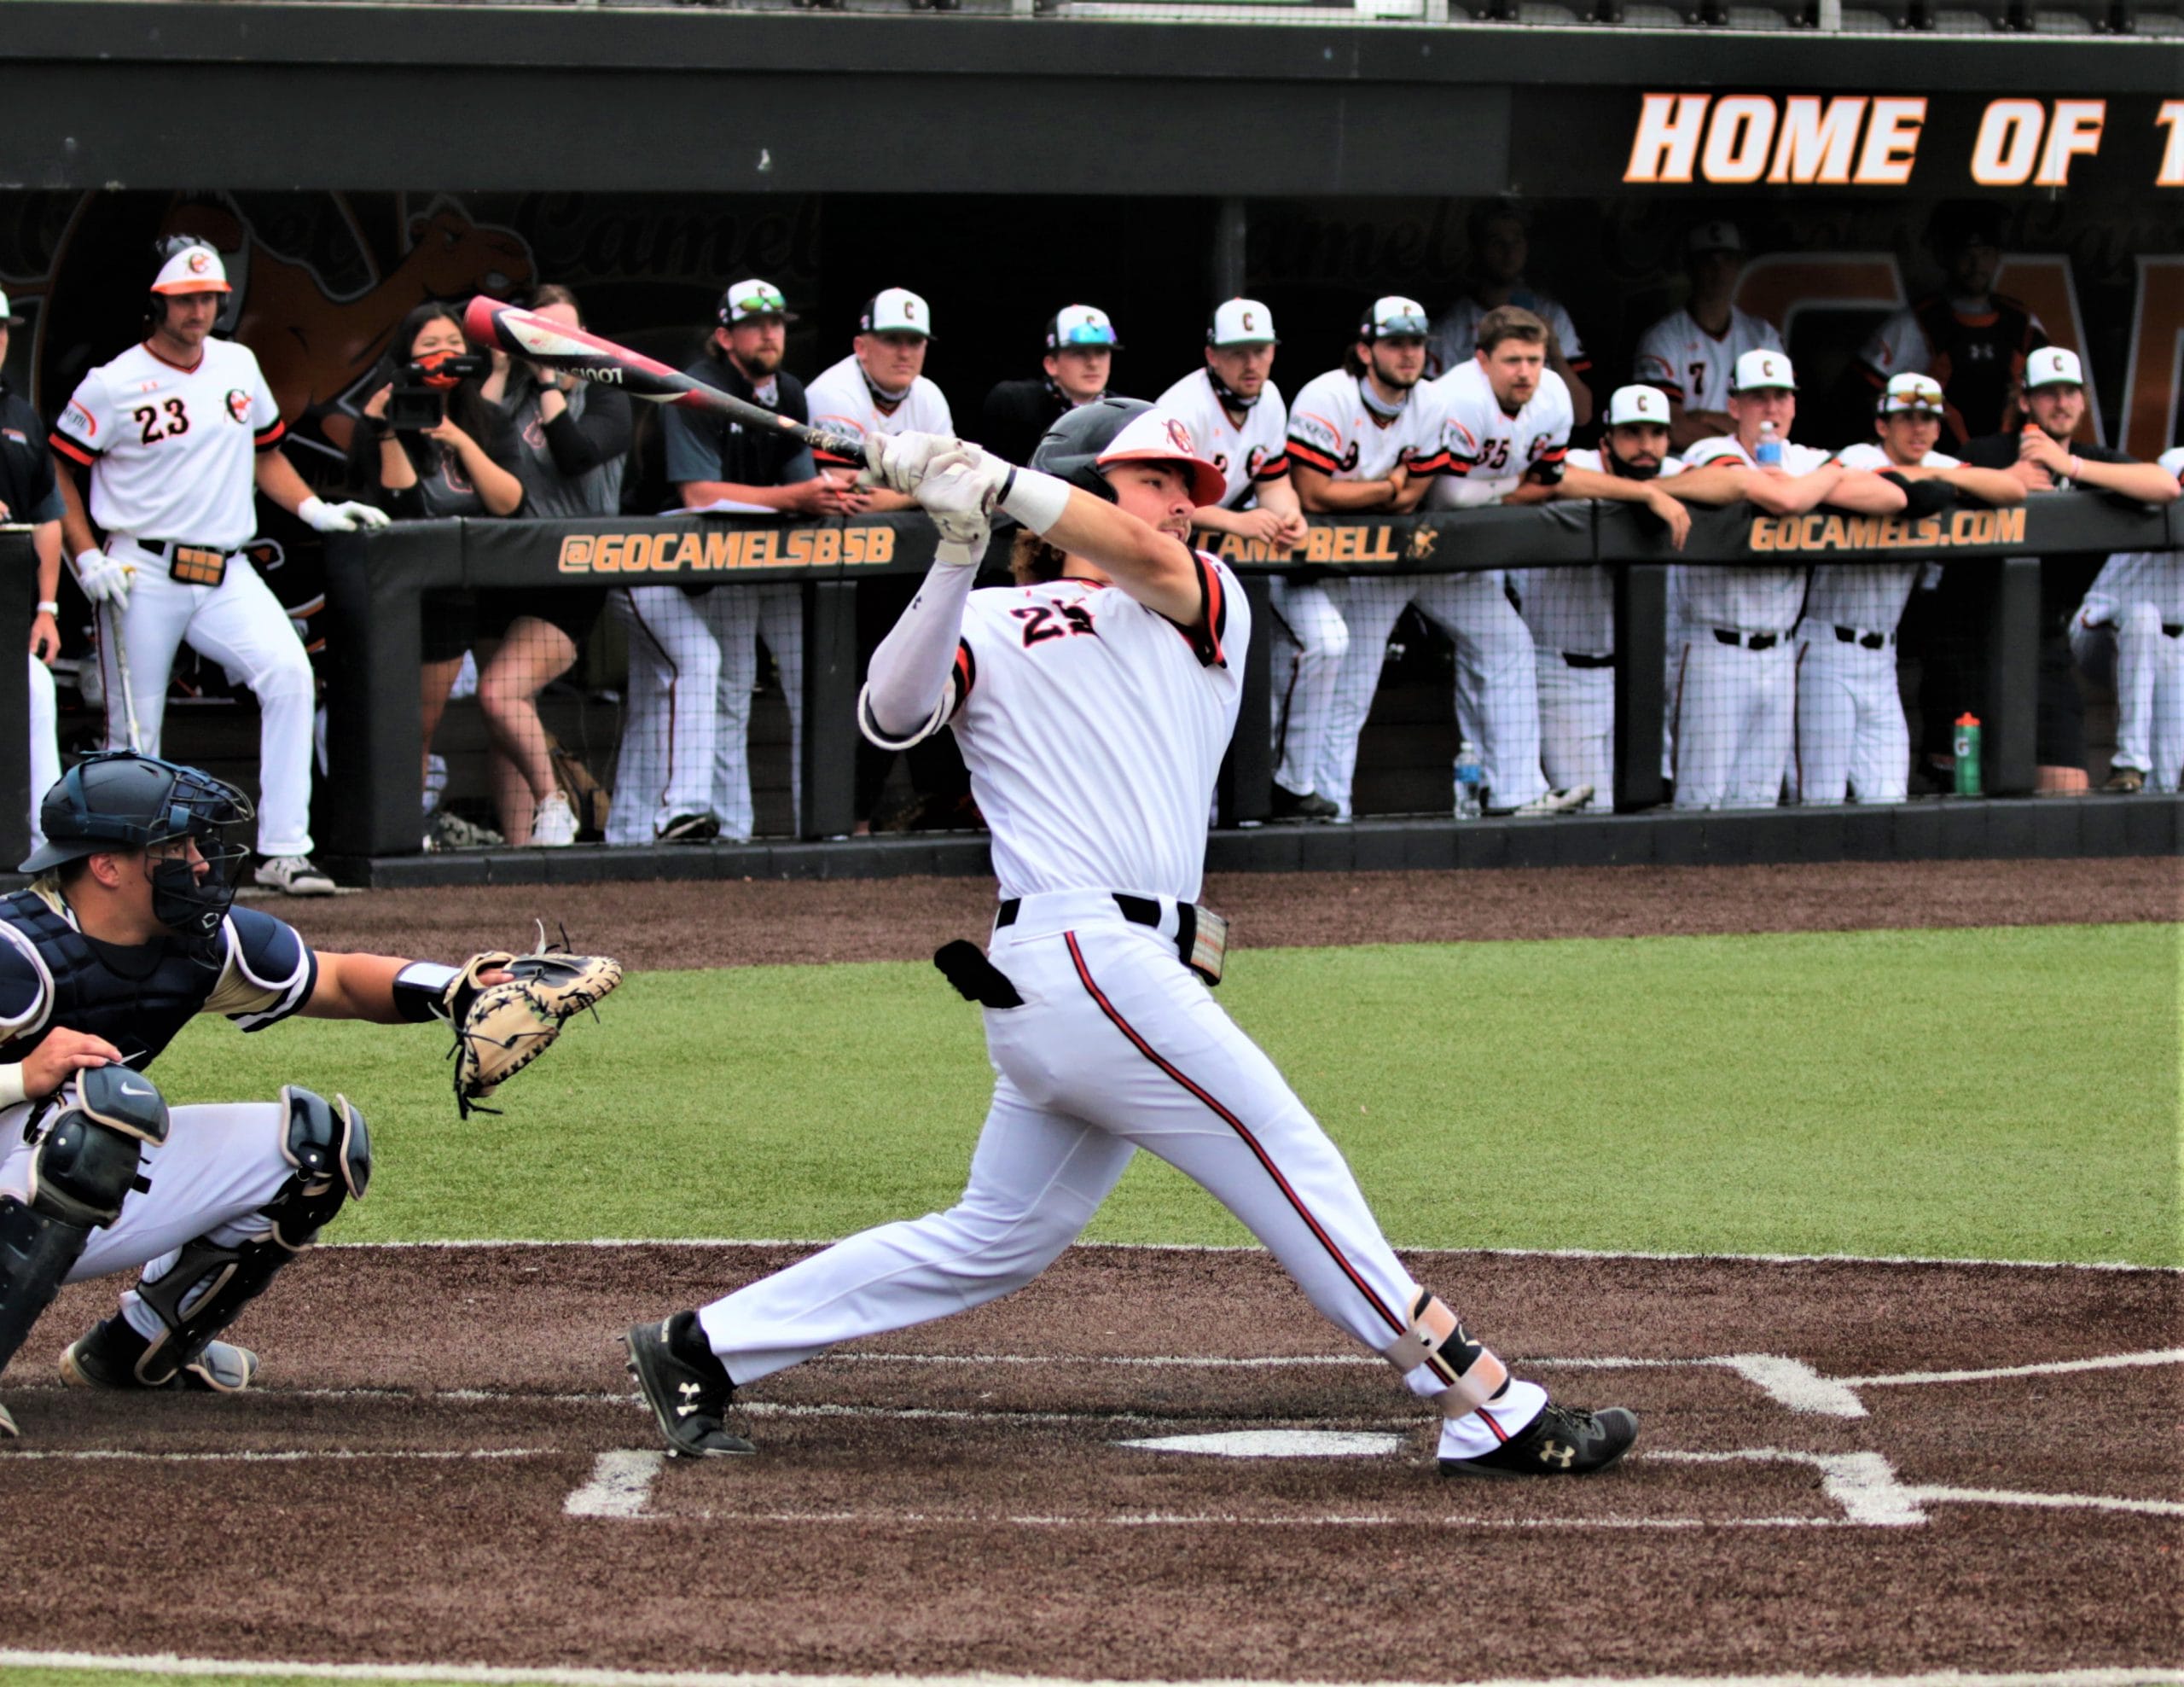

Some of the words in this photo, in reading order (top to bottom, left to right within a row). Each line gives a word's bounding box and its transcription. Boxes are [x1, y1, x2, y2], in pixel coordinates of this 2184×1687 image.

[1623, 93, 1928, 183] HOME
[1970, 98, 2106, 186] OF
[903, 301, 915, 320] C
[1243, 312, 1253, 332] C
[1763, 360, 1774, 377] C
[2053, 355, 2064, 371] C
[1688, 363, 1705, 395] 7
[1637, 395, 1647, 411] C
[134, 398, 189, 445] 23
[1750, 508, 2026, 551] GOCAMELS.COM
[558, 526, 896, 573] @GOCAMELSBSB
[1954, 736, 1970, 758] G
